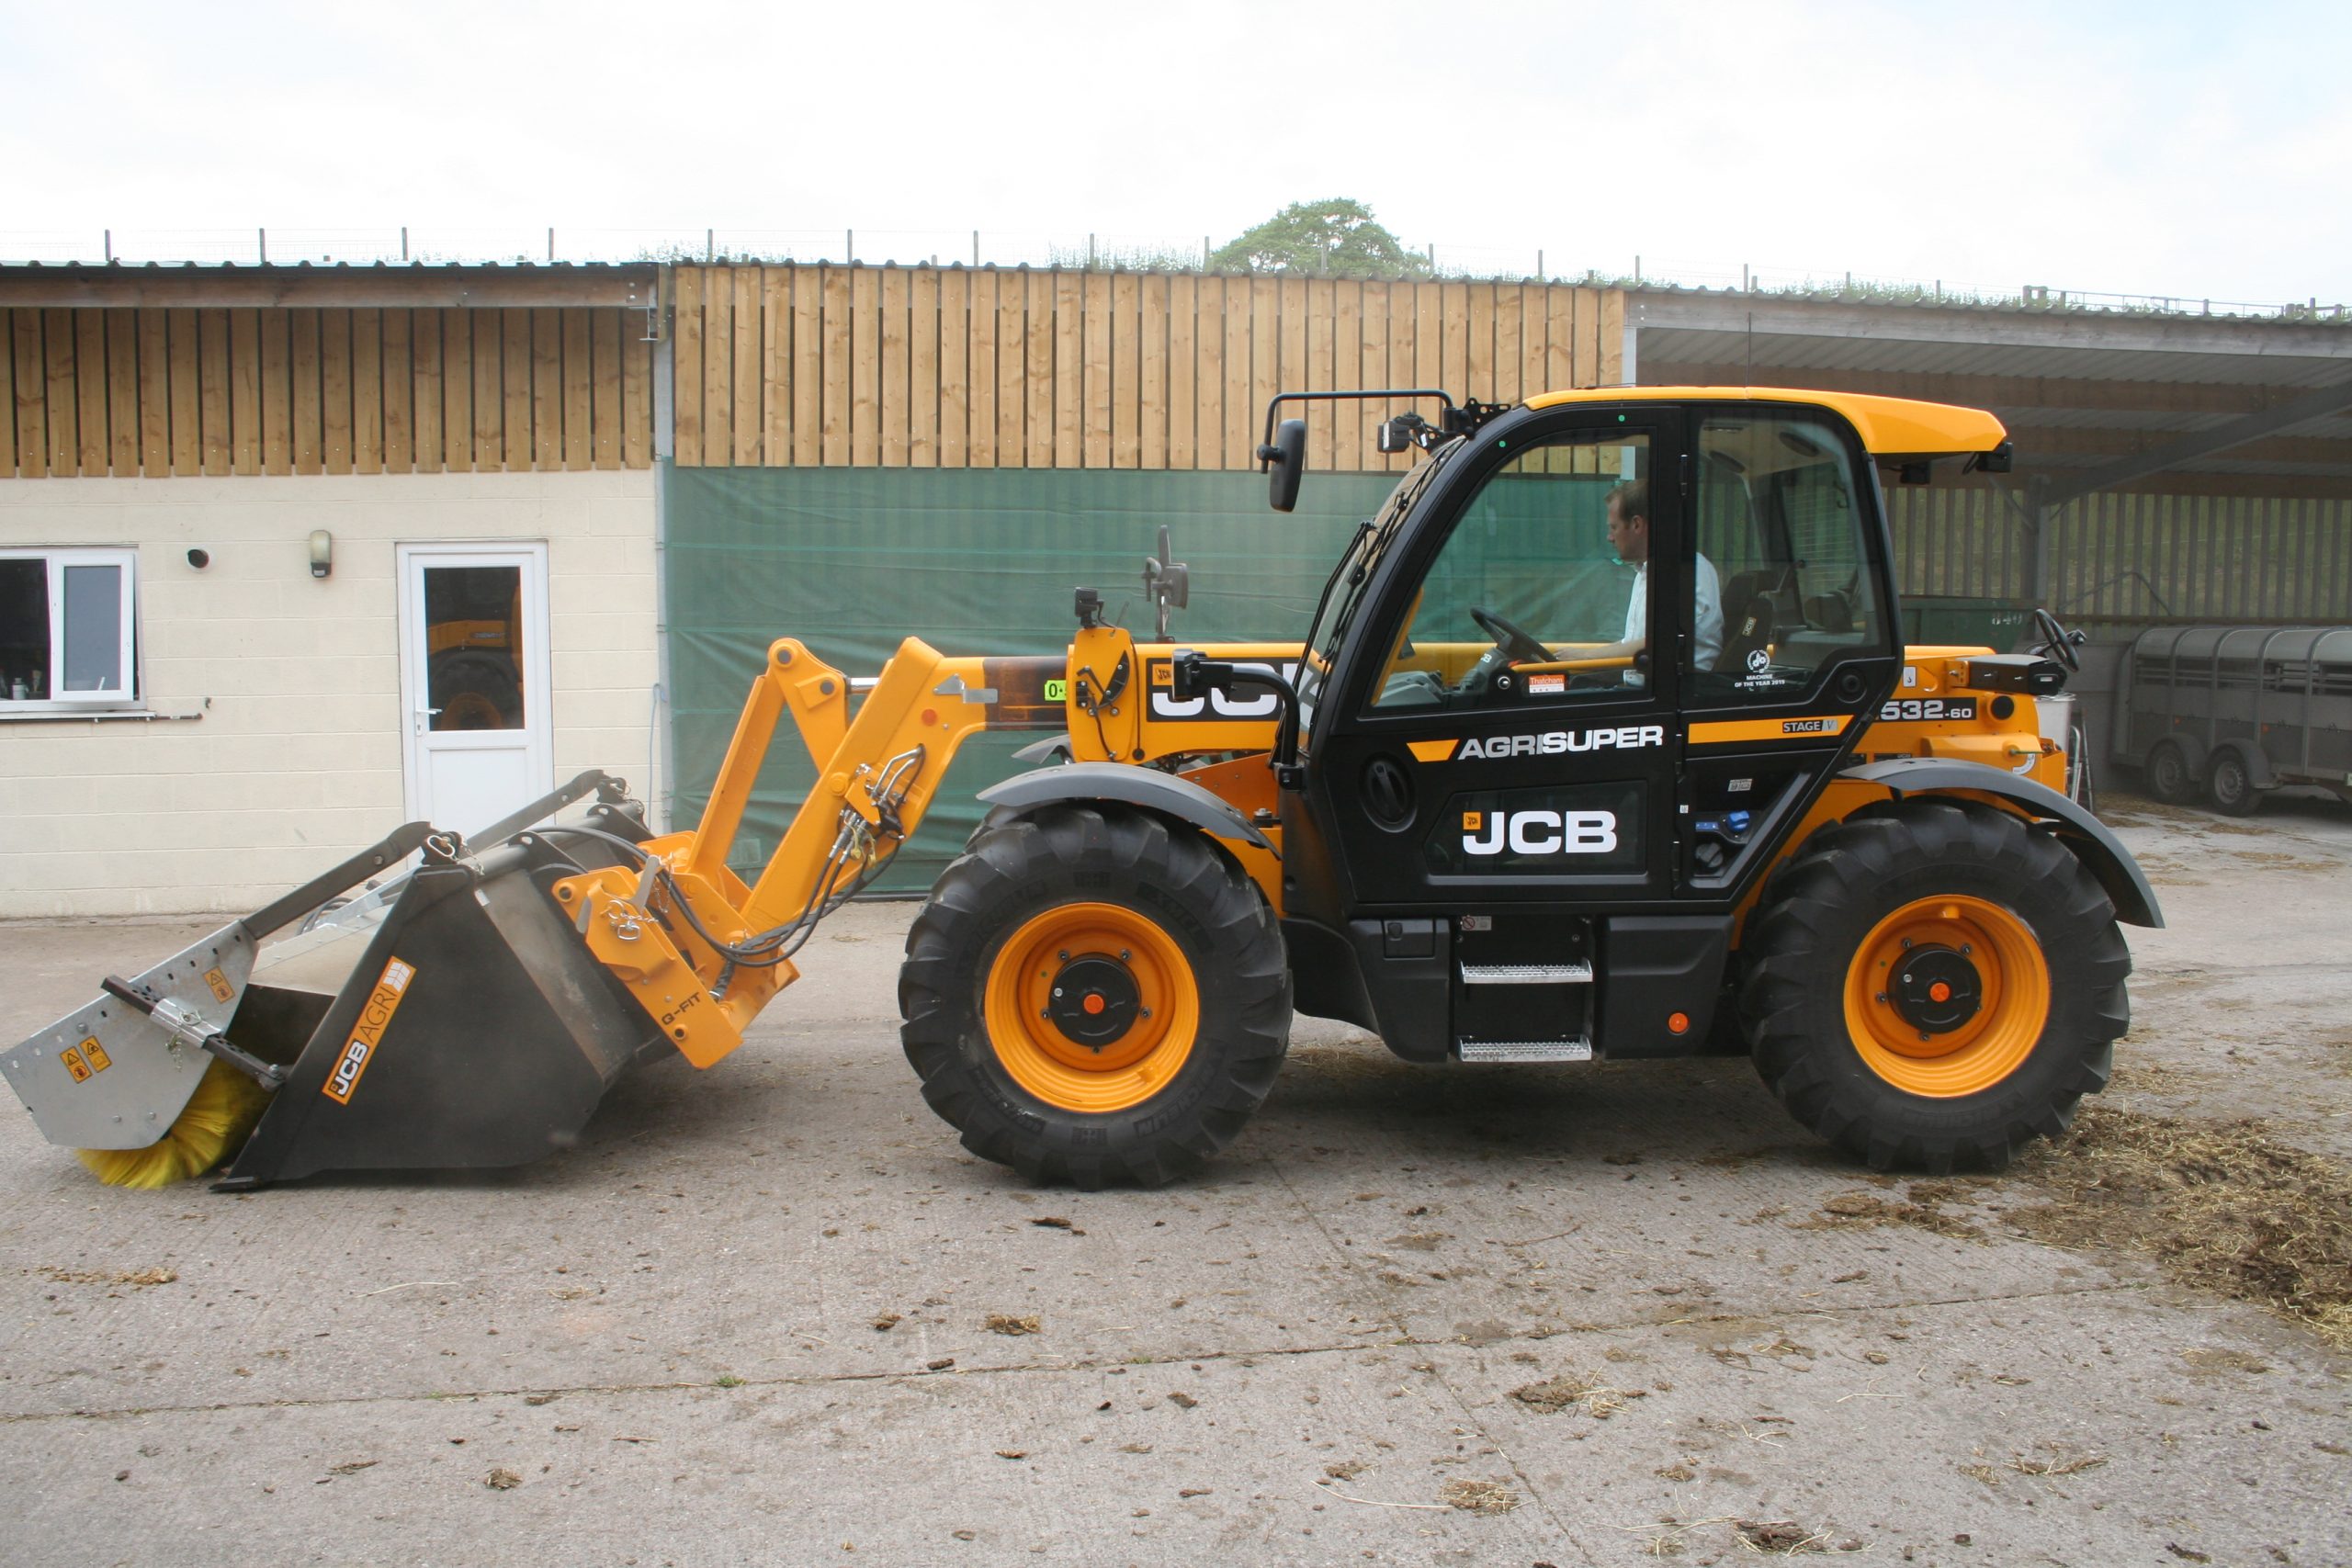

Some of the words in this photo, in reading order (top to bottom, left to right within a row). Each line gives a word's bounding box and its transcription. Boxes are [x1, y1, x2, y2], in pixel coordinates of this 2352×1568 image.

[1783, 720, 1822, 733] STAGE
[1826, 719, 1835, 730] V
[1880, 700, 1973, 721] 532-60
[1457, 725, 1664, 761] AGRISUPER
[1463, 810, 1618, 855] JCB
[337, 1040, 368, 1096] JCB
[359, 986, 398, 1043] AGRI
